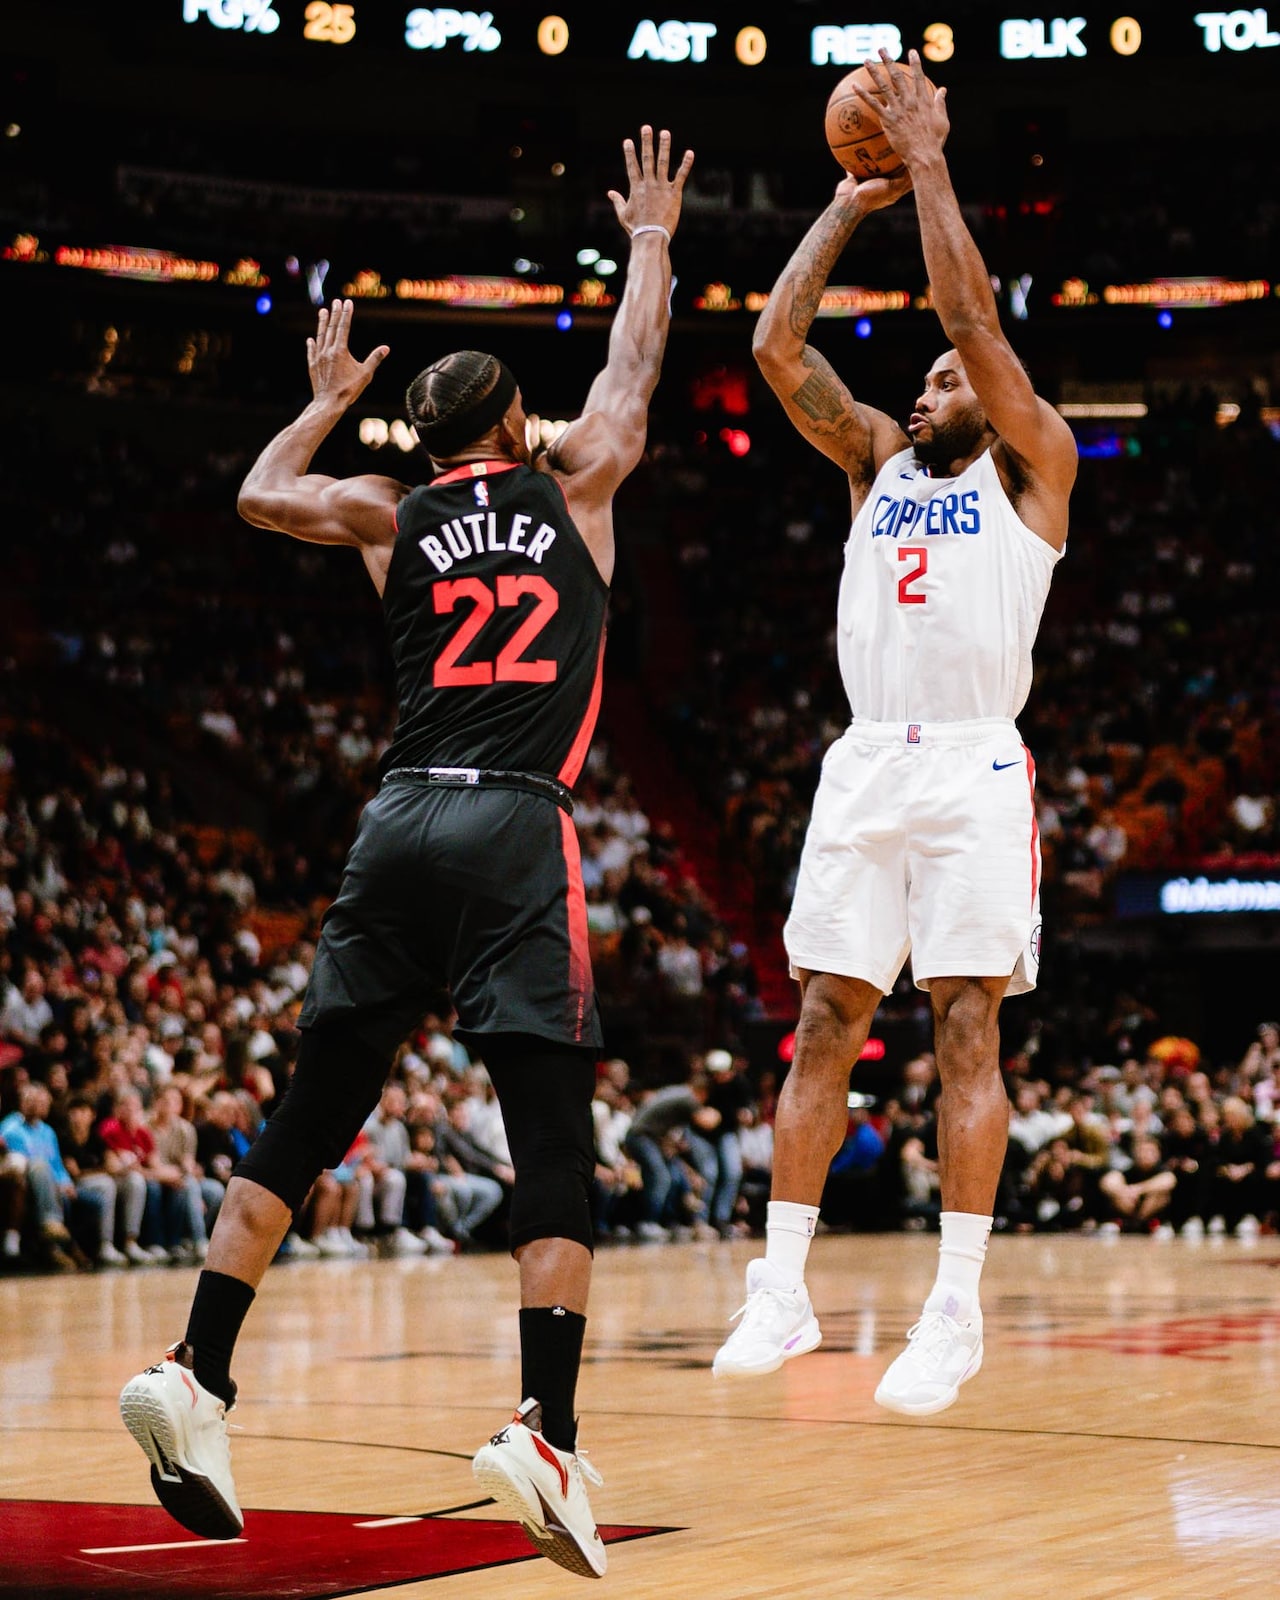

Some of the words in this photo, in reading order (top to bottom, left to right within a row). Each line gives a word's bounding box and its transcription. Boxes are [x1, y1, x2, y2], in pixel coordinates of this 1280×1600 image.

[303, 1, 357, 44] 25
[404, 8, 502, 52] 3P%
[537, 15, 570, 56] 0
[627, 19, 718, 63] AST
[735, 26, 768, 66] 0
[810, 23, 903, 66] REB
[921, 22, 955, 63] 3
[1000, 16, 1088, 60] BLK
[1110, 16, 1142, 56] 0
[1193, 8, 1280, 53] TOL
[418, 511, 557, 574] BUTLER
[897, 547, 928, 604] 2
[432, 574, 559, 688] 22
